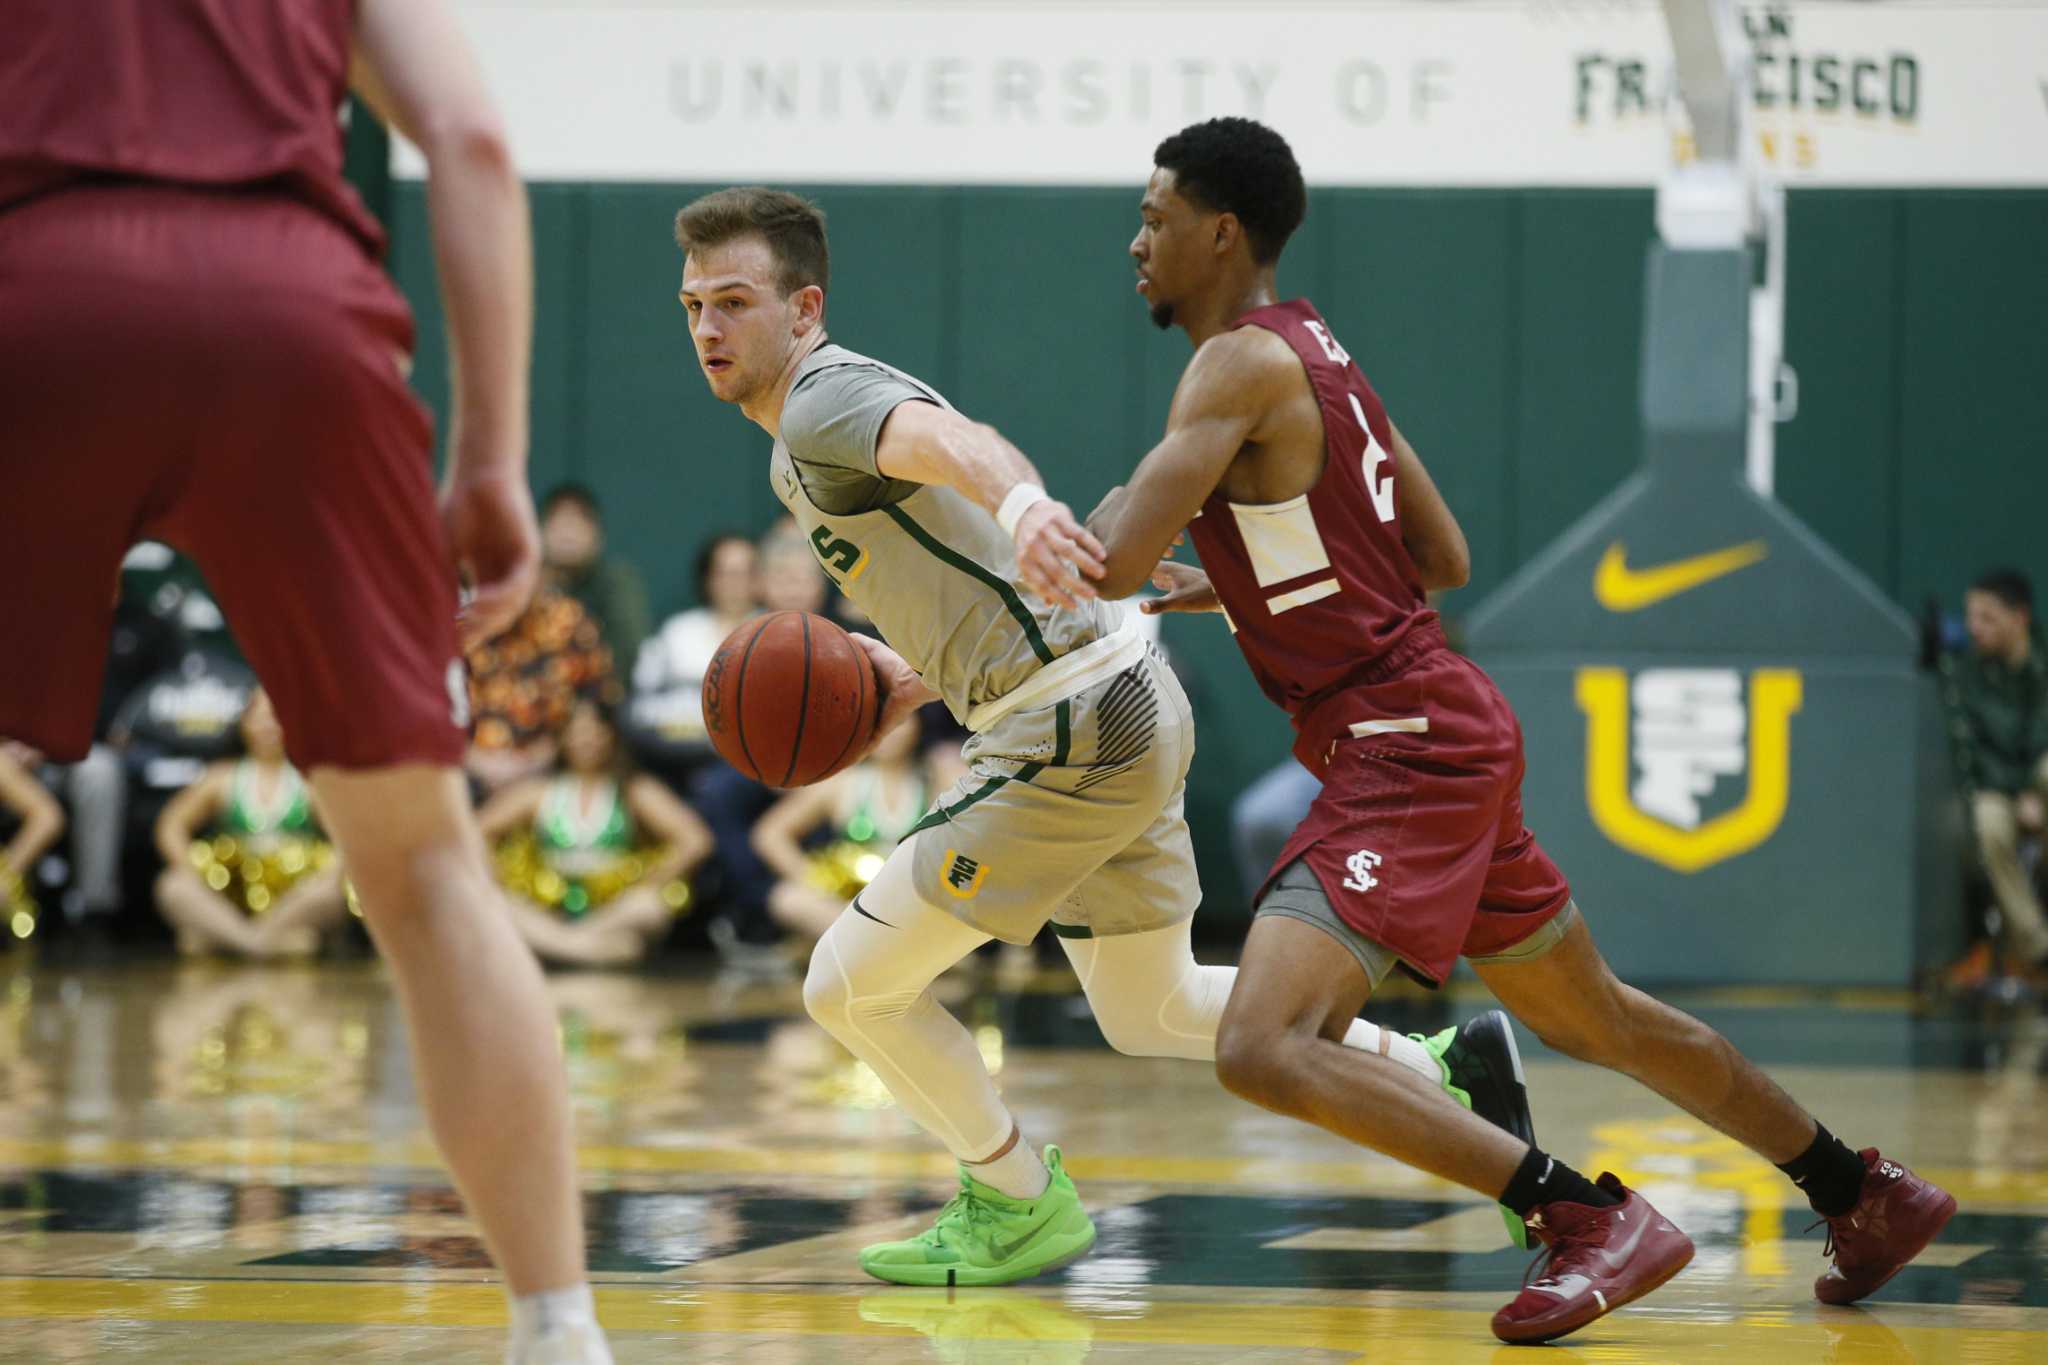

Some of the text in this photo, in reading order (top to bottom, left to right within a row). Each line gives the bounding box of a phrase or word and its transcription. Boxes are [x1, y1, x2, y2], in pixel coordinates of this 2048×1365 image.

[667, 57, 1457, 127] UNIVERSITY OF
[1574, 53, 1919, 125] FRCISCO
